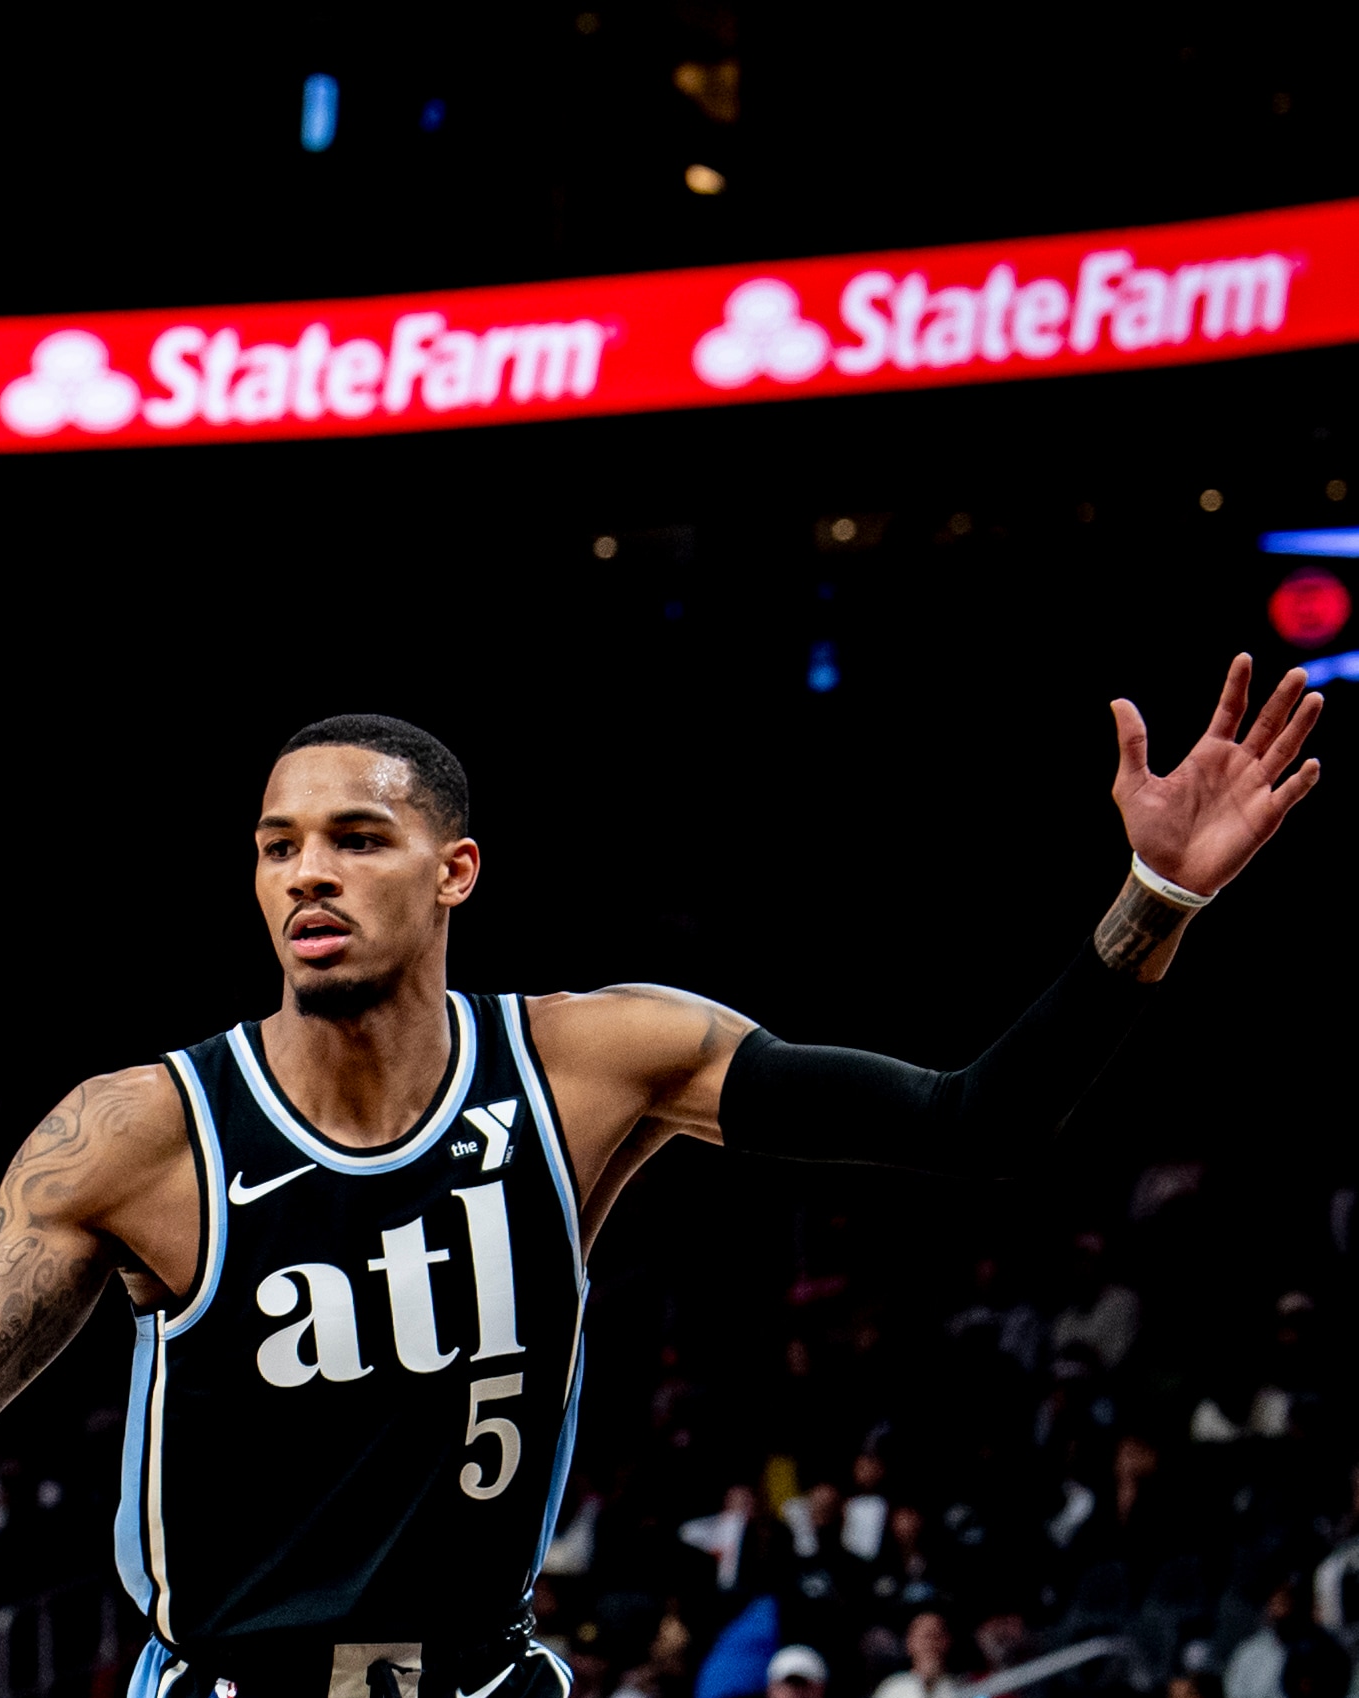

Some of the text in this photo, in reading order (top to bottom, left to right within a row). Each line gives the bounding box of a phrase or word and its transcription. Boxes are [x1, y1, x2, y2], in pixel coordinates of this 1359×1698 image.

[450, 1140, 479, 1158] the
[256, 1180, 527, 1388] atl
[459, 1371, 524, 1501] 5
